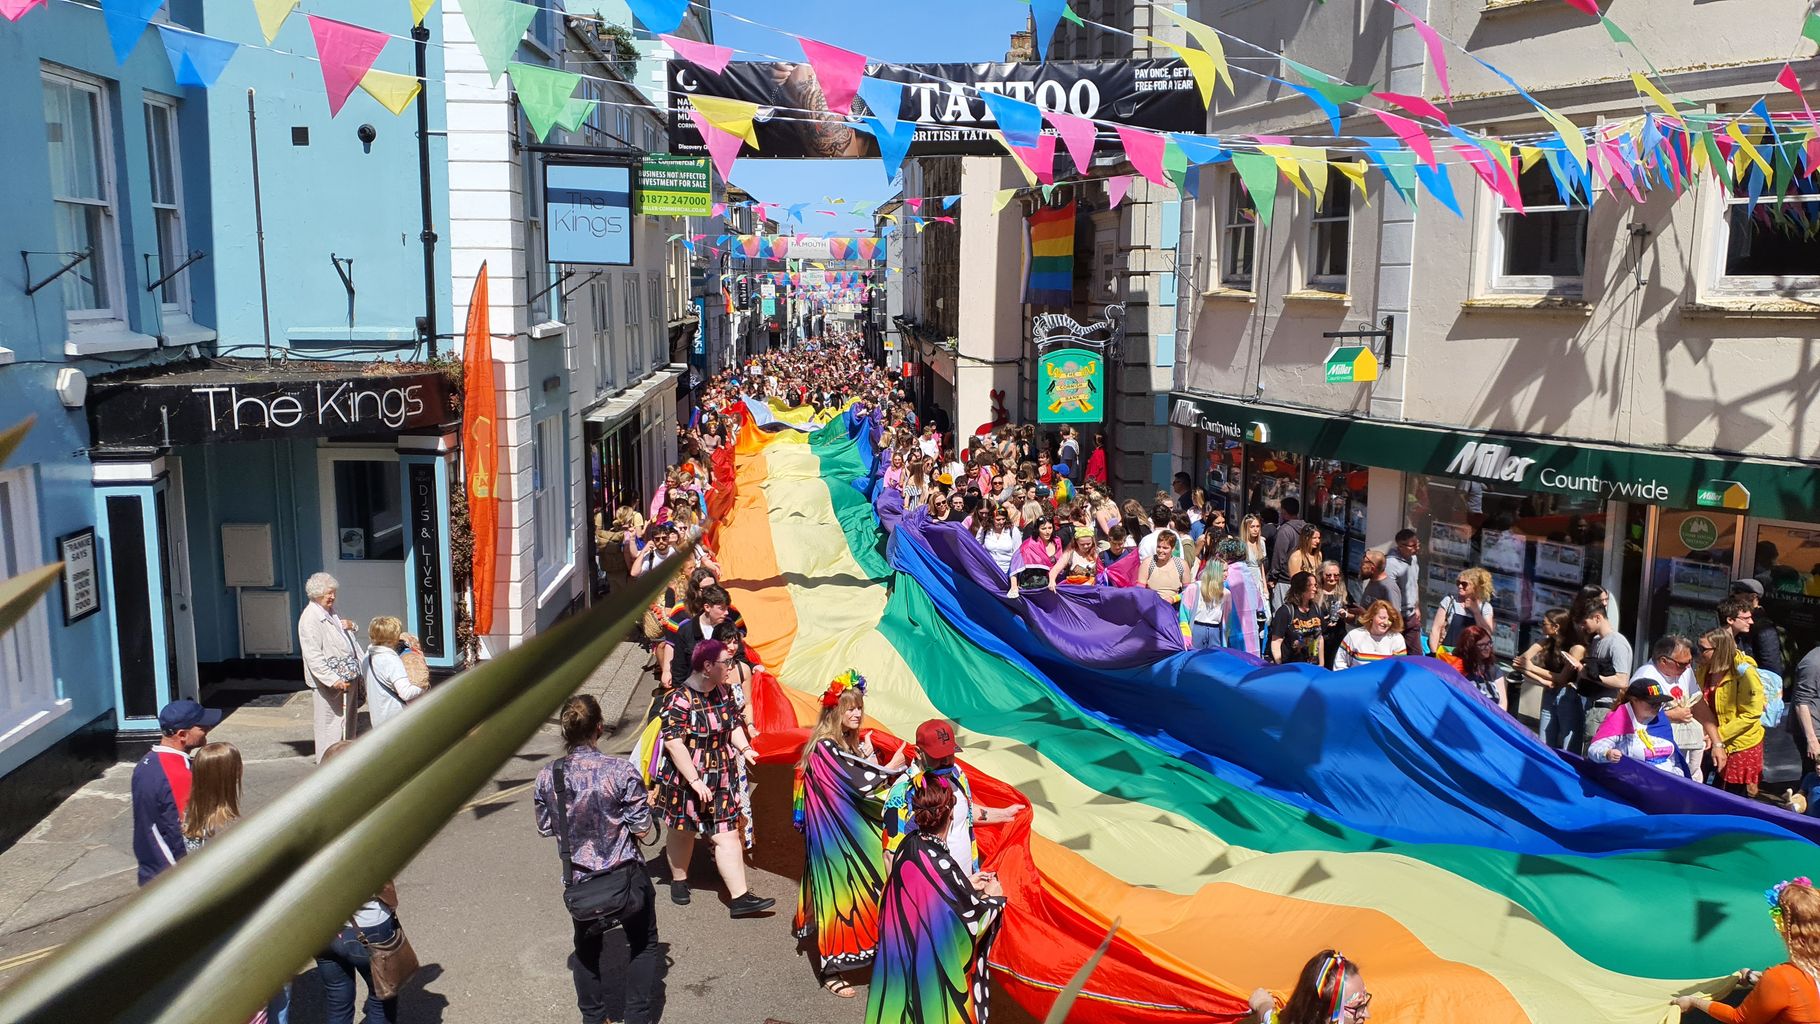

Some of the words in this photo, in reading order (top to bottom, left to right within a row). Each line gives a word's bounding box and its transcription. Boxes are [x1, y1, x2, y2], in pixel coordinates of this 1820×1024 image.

[1135, 68, 1149, 79] PAY
[1150, 68, 1171, 79] ONCE,
[1173, 67, 1188, 78] GET
[1135, 81, 1153, 91] FREE
[1154, 80, 1167, 90] FOR
[1168, 80, 1173, 90] A
[1174, 80, 1194, 90] YEAR!
[912, 130, 960, 141] BRITISH
[678, 143, 702, 151] Discovery
[639, 170, 666, 178] BUSINESS
[667, 171, 678, 179] NOT
[679, 172, 707, 180] AFFECTED
[639, 178, 678, 187] INVESTMENT
[679, 179, 691, 187] FOR
[692, 180, 707, 189] SALE
[566, 191, 606, 211] The
[640, 194, 669, 204] 01872
[671, 196, 707, 206] 247000
[555, 208, 622, 238] Kings
[1327, 363, 1353, 376] Miller
[191, 386, 302, 432] The
[315, 381, 424, 429] Kings
[1200, 416, 1241, 438] Countrywide
[1445, 441, 1537, 483] Miller
[1540, 467, 1669, 501] Countrywide
[1698, 491, 1722, 501] Miller
[420, 527, 432, 539] &
[421, 545, 433, 588] LIVE
[424, 594, 435, 647] MUSIC
